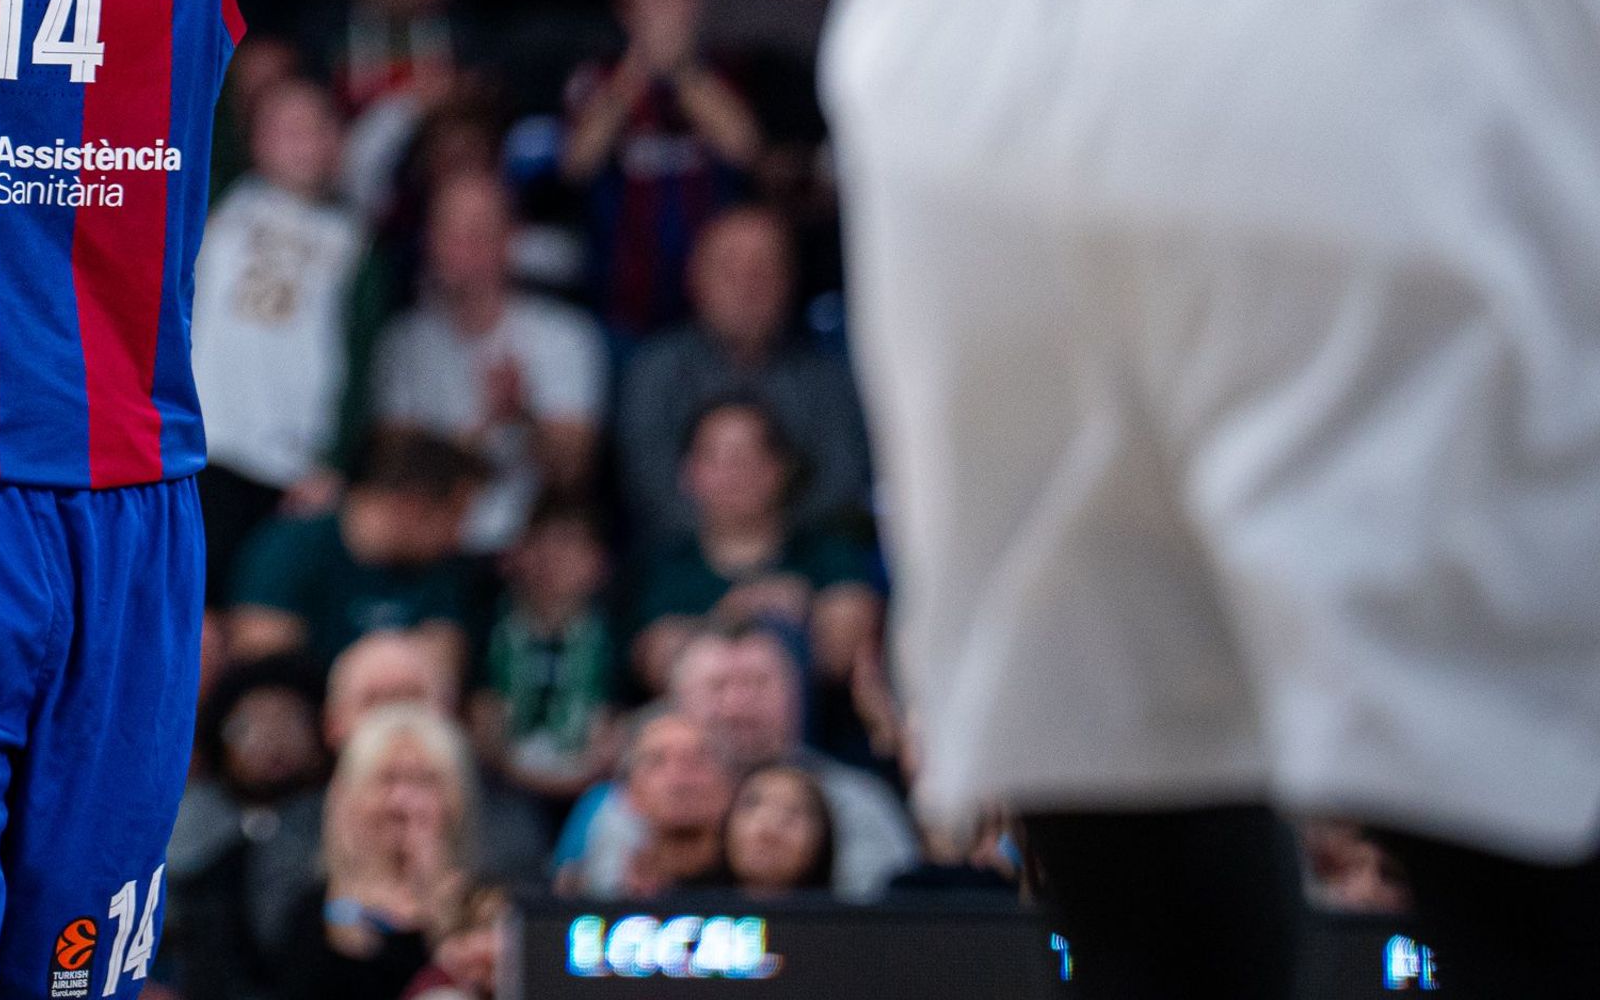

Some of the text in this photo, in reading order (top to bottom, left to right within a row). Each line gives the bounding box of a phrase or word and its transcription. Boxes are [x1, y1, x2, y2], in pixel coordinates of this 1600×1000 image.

[102, 862, 166, 997] 14
[53, 970, 89, 980] TURKISH
[52, 979, 88, 989] AIRLINES
[51, 988, 88, 998] EuroLeague
